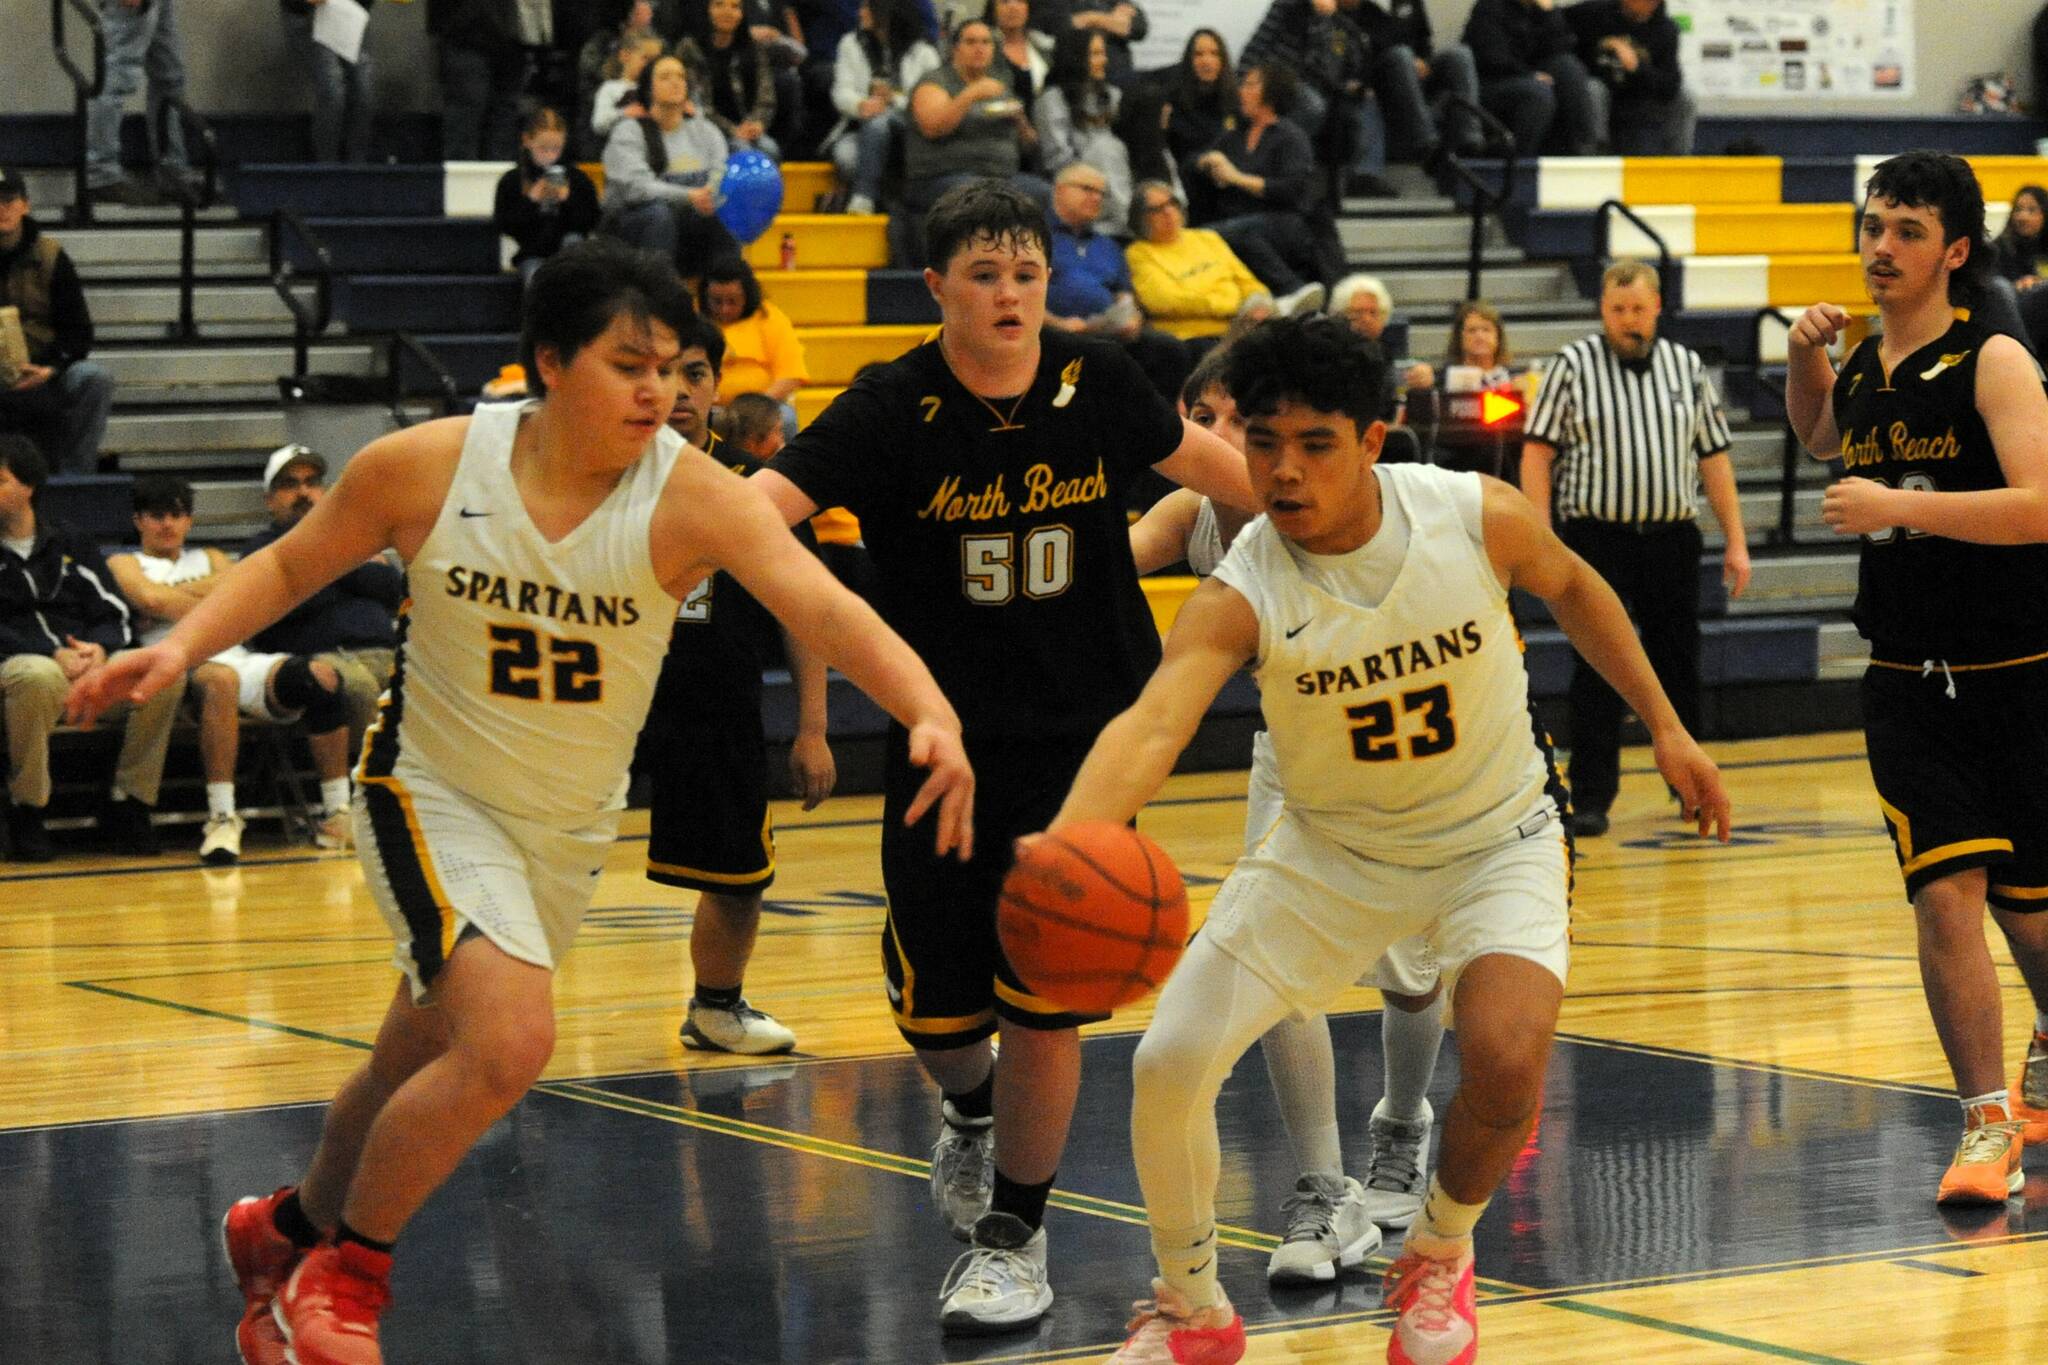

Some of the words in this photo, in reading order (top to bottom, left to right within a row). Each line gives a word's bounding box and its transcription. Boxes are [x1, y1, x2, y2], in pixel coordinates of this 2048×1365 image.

[919, 395, 943, 423] 7
[1889, 420, 1962, 462] Beach
[917, 473, 1011, 522] North
[1018, 455, 1108, 513] Beach
[445, 565, 640, 628] SPARTANS
[961, 522, 1075, 606] 50
[486, 621, 604, 704] 22
[1295, 620, 1483, 696] SPARTANS
[1342, 681, 1460, 763] 23
